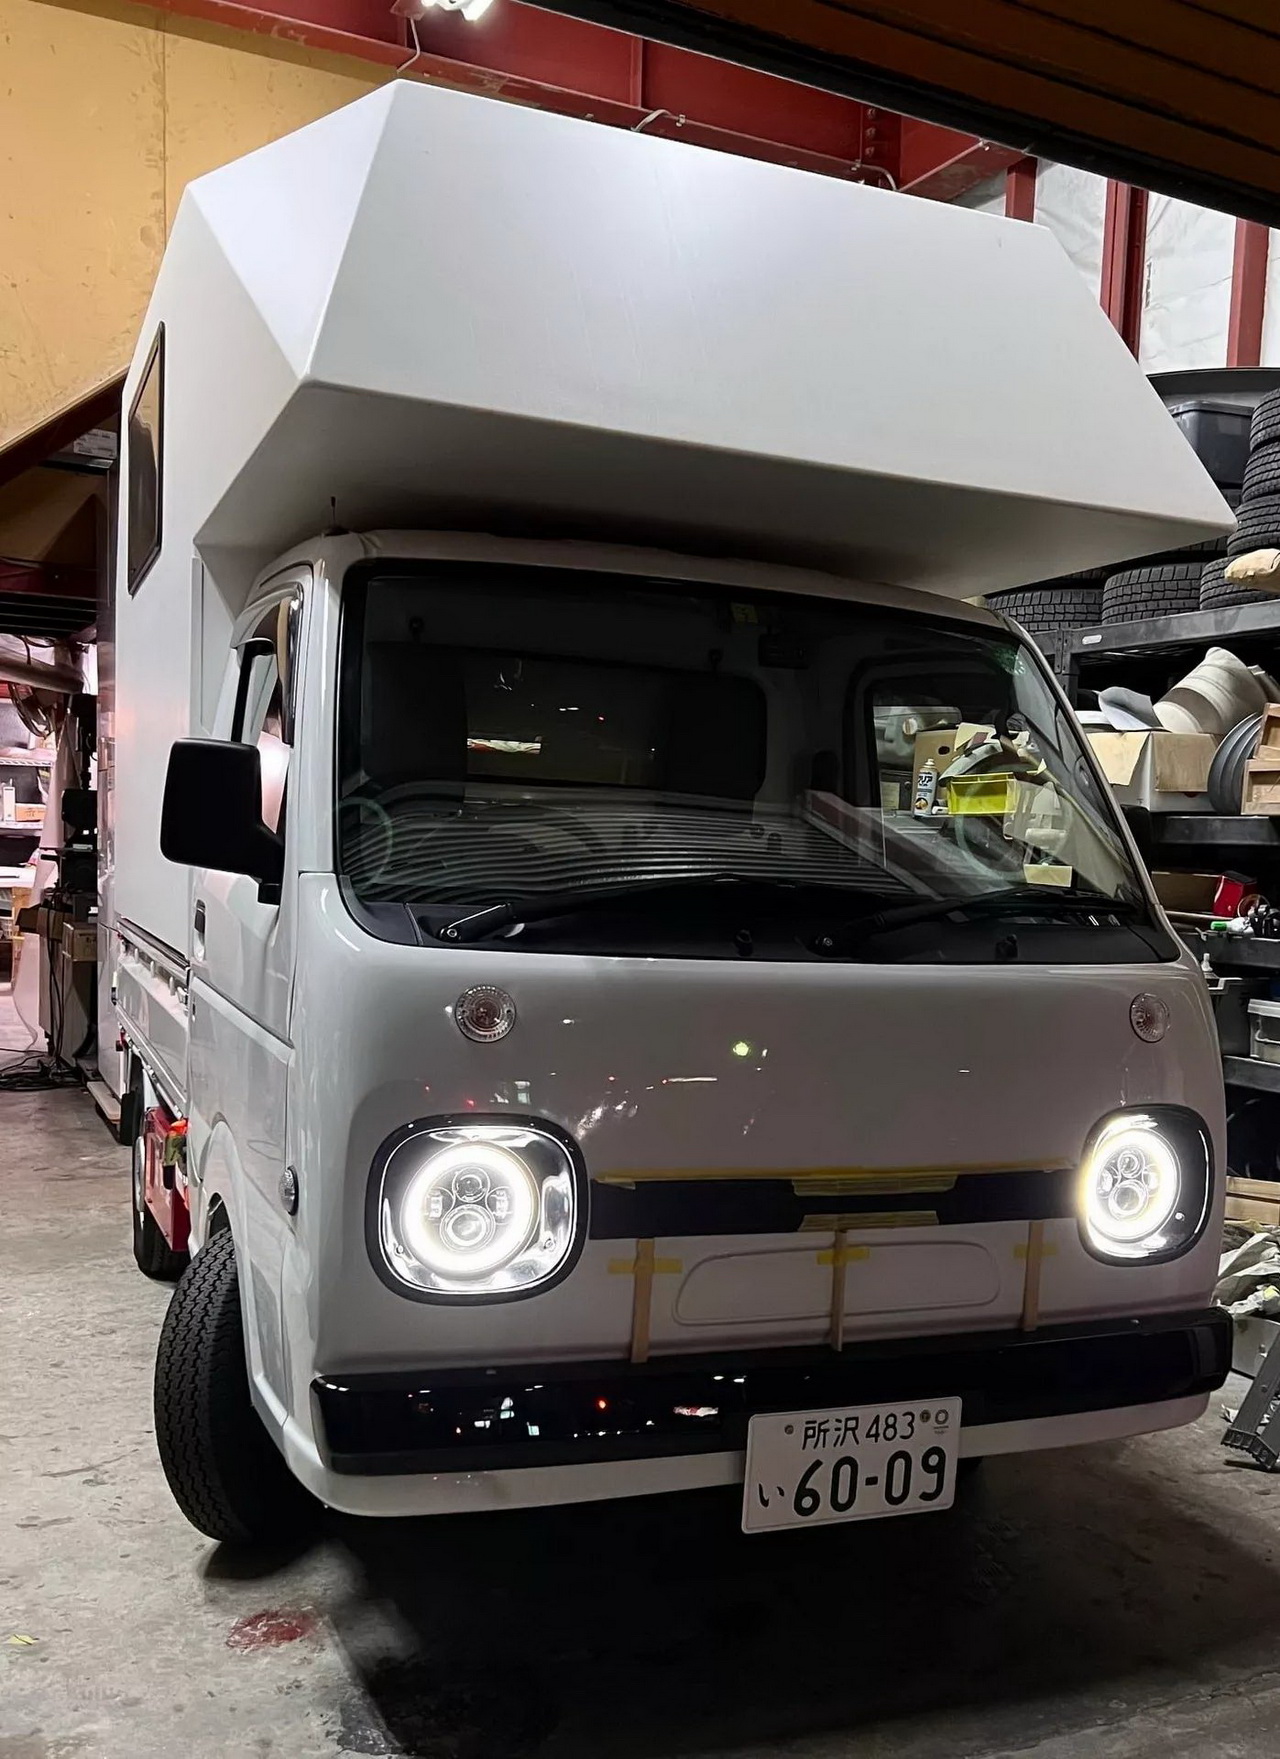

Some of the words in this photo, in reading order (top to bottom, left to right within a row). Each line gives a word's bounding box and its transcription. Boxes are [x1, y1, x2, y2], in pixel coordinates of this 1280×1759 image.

[802, 1415, 860, 1450] 所沢
[865, 1411, 915, 1444] 483
[758, 1483, 785, 1508] い
[793, 1445, 947, 1517] 60-09
